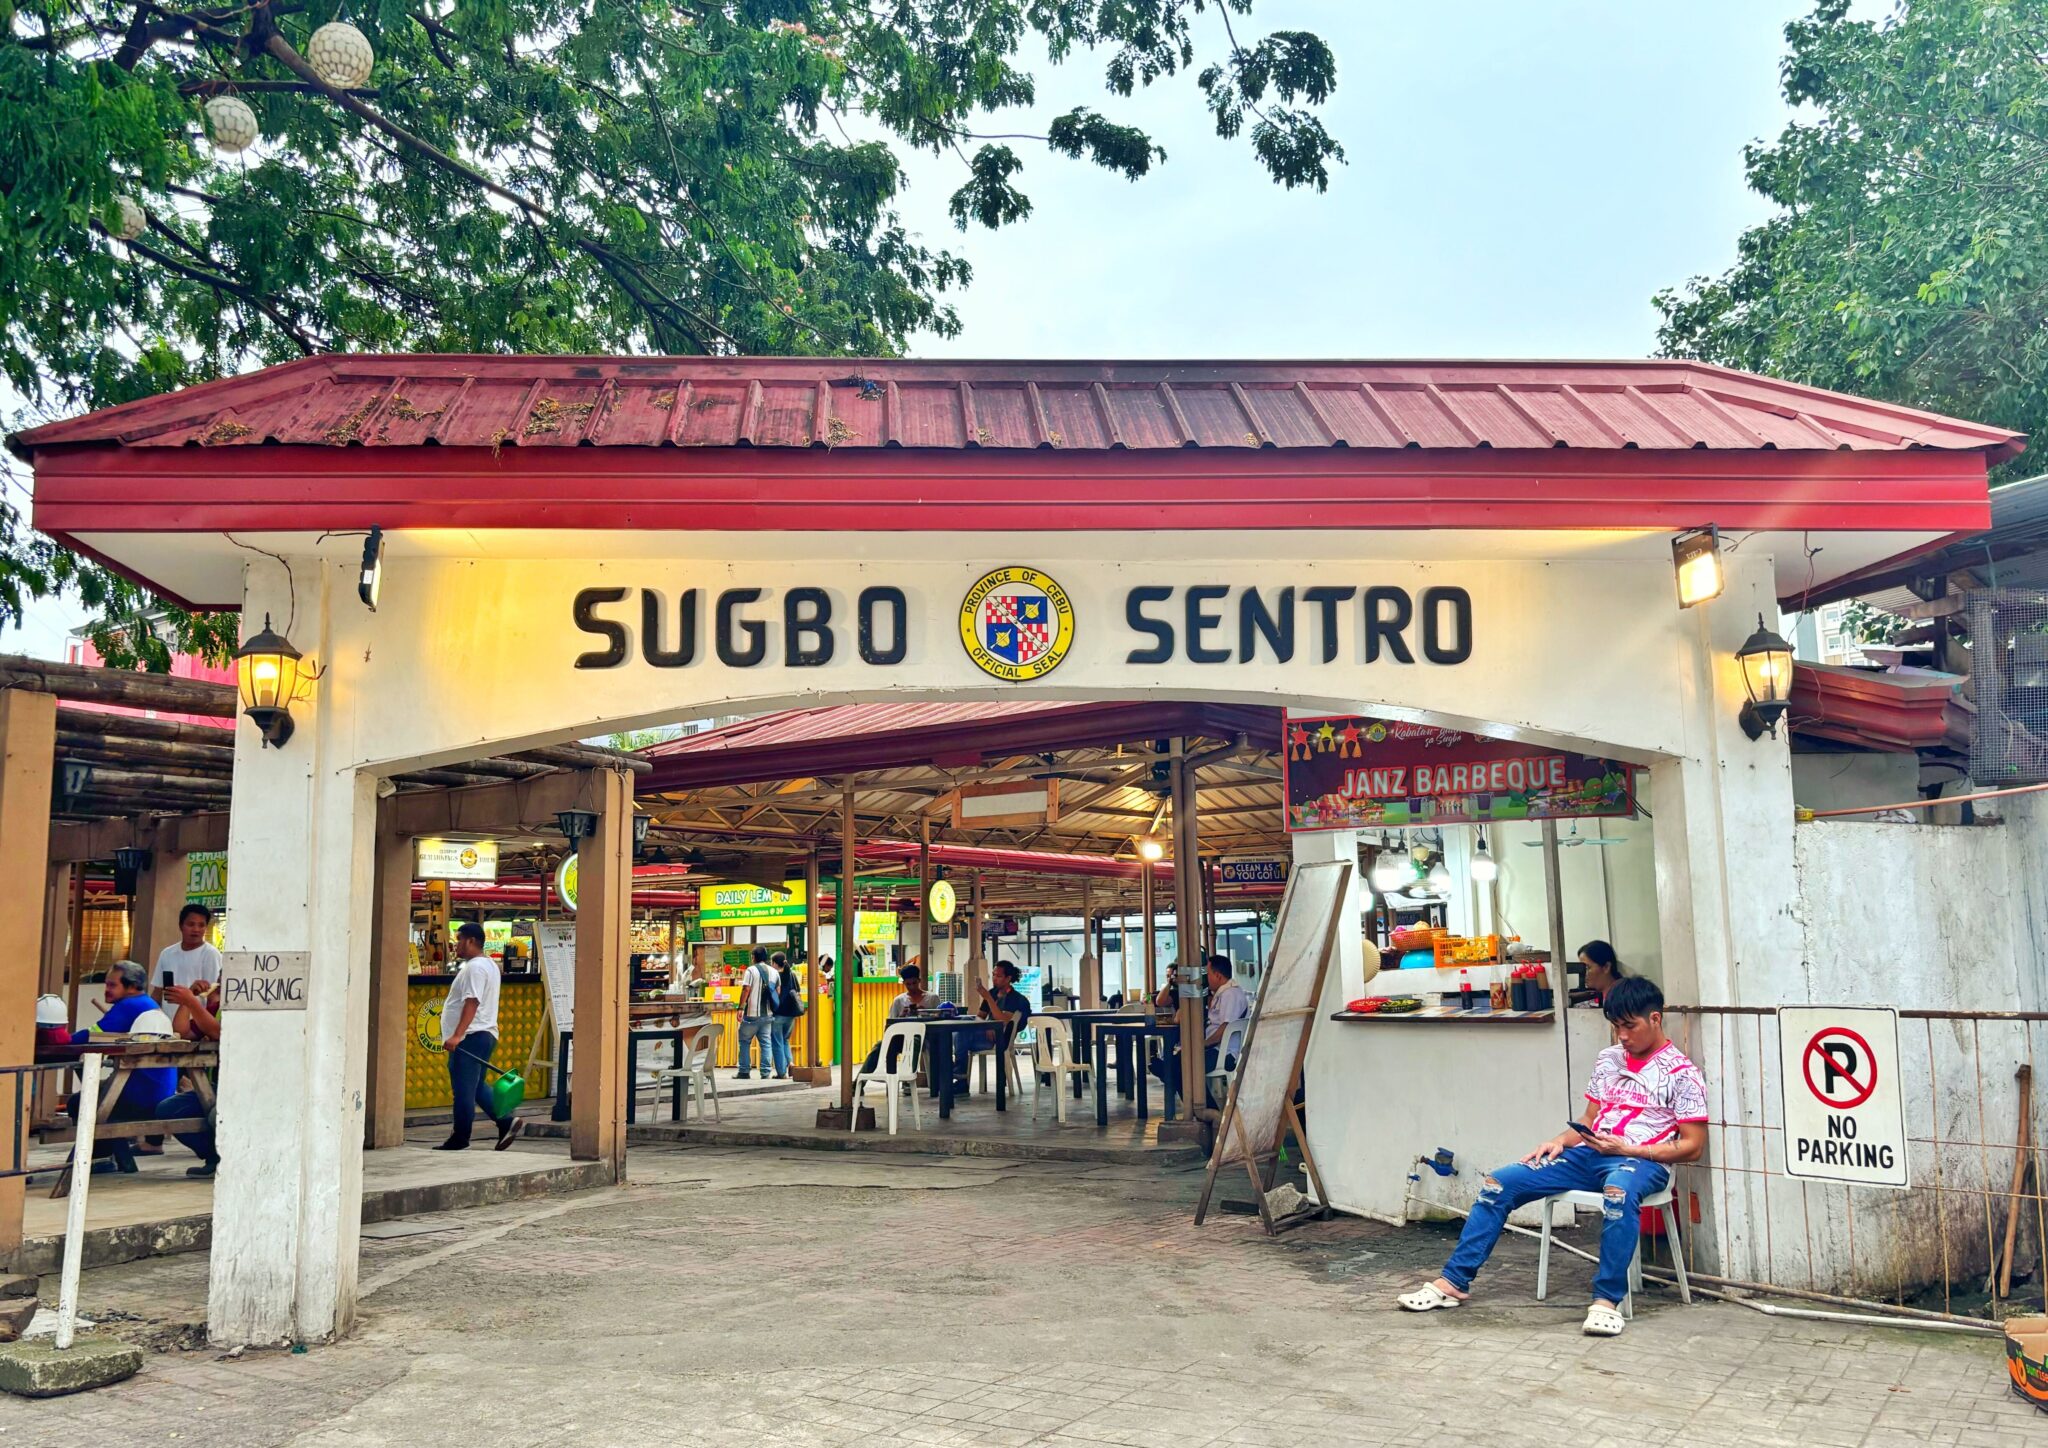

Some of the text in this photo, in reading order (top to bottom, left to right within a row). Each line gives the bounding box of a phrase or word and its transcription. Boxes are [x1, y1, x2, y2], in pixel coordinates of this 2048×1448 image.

[965, 571, 1069, 614] PROVINCE OF CEBU
[573, 585, 1473, 668] SUGBO SENTRO
[972, 647, 1063, 678] OFFICIAL SEAL
[1339, 756, 1565, 799] JANZ BARBEQUE
[1236, 863, 1273, 872] CLEAN AS
[1237, 871, 1273, 880] YOU GO!
[715, 888, 789, 905] DAILY LEMN
[720, 910, 735, 918] 100%
[254, 954, 279, 972] NO
[224, 977, 303, 1004] PARKING
[1828, 1115, 1857, 1139] NO
[1797, 1138, 1894, 1169] PARKING
